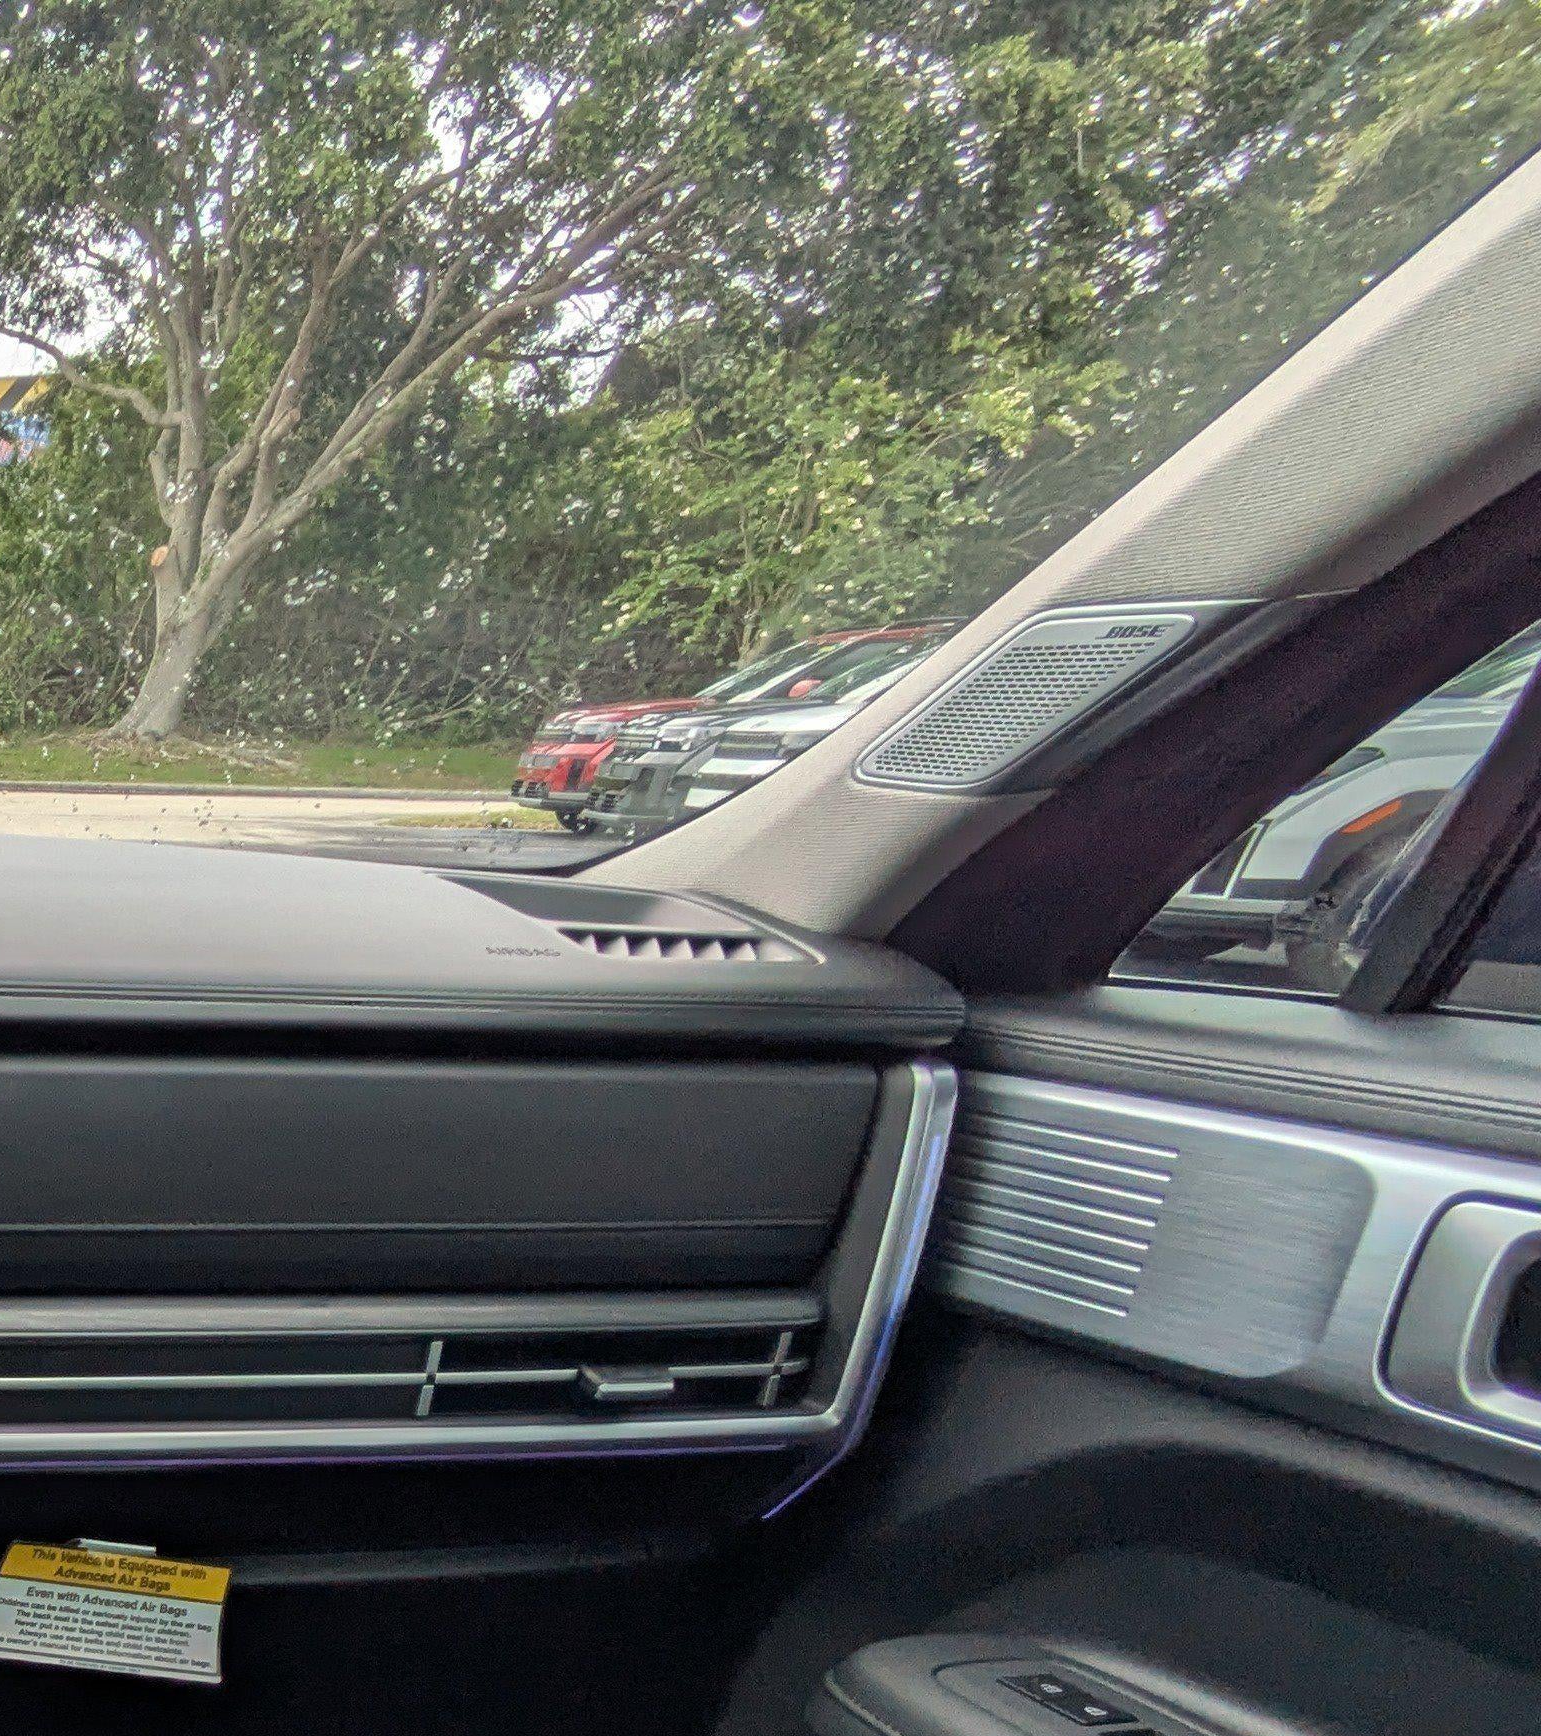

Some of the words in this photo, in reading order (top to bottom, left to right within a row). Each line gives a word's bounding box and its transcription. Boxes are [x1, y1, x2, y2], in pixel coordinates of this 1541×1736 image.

[1105, 624, 1165, 639] BOSE
[32, 1548, 56, 1560] This
[119, 1558, 178, 1576] Equipped
[181, 1567, 206, 1580] with
[54, 1565, 116, 1583] Advanced
[118, 1574, 136, 1585] Air
[140, 1576, 171, 1592] Bags
[26, 1586, 54, 1599] Even
[57, 1591, 80, 1602] with
[82, 1594, 138, 1610] Advanced
[140, 1601, 157, 1612] Air
[160, 1603, 188, 1618] Bags
[31, 1602, 46, 1610] can
[17, 1608, 31, 1617] The
[32, 1611, 51, 1620] back
[39, 1622, 53, 1630] put
